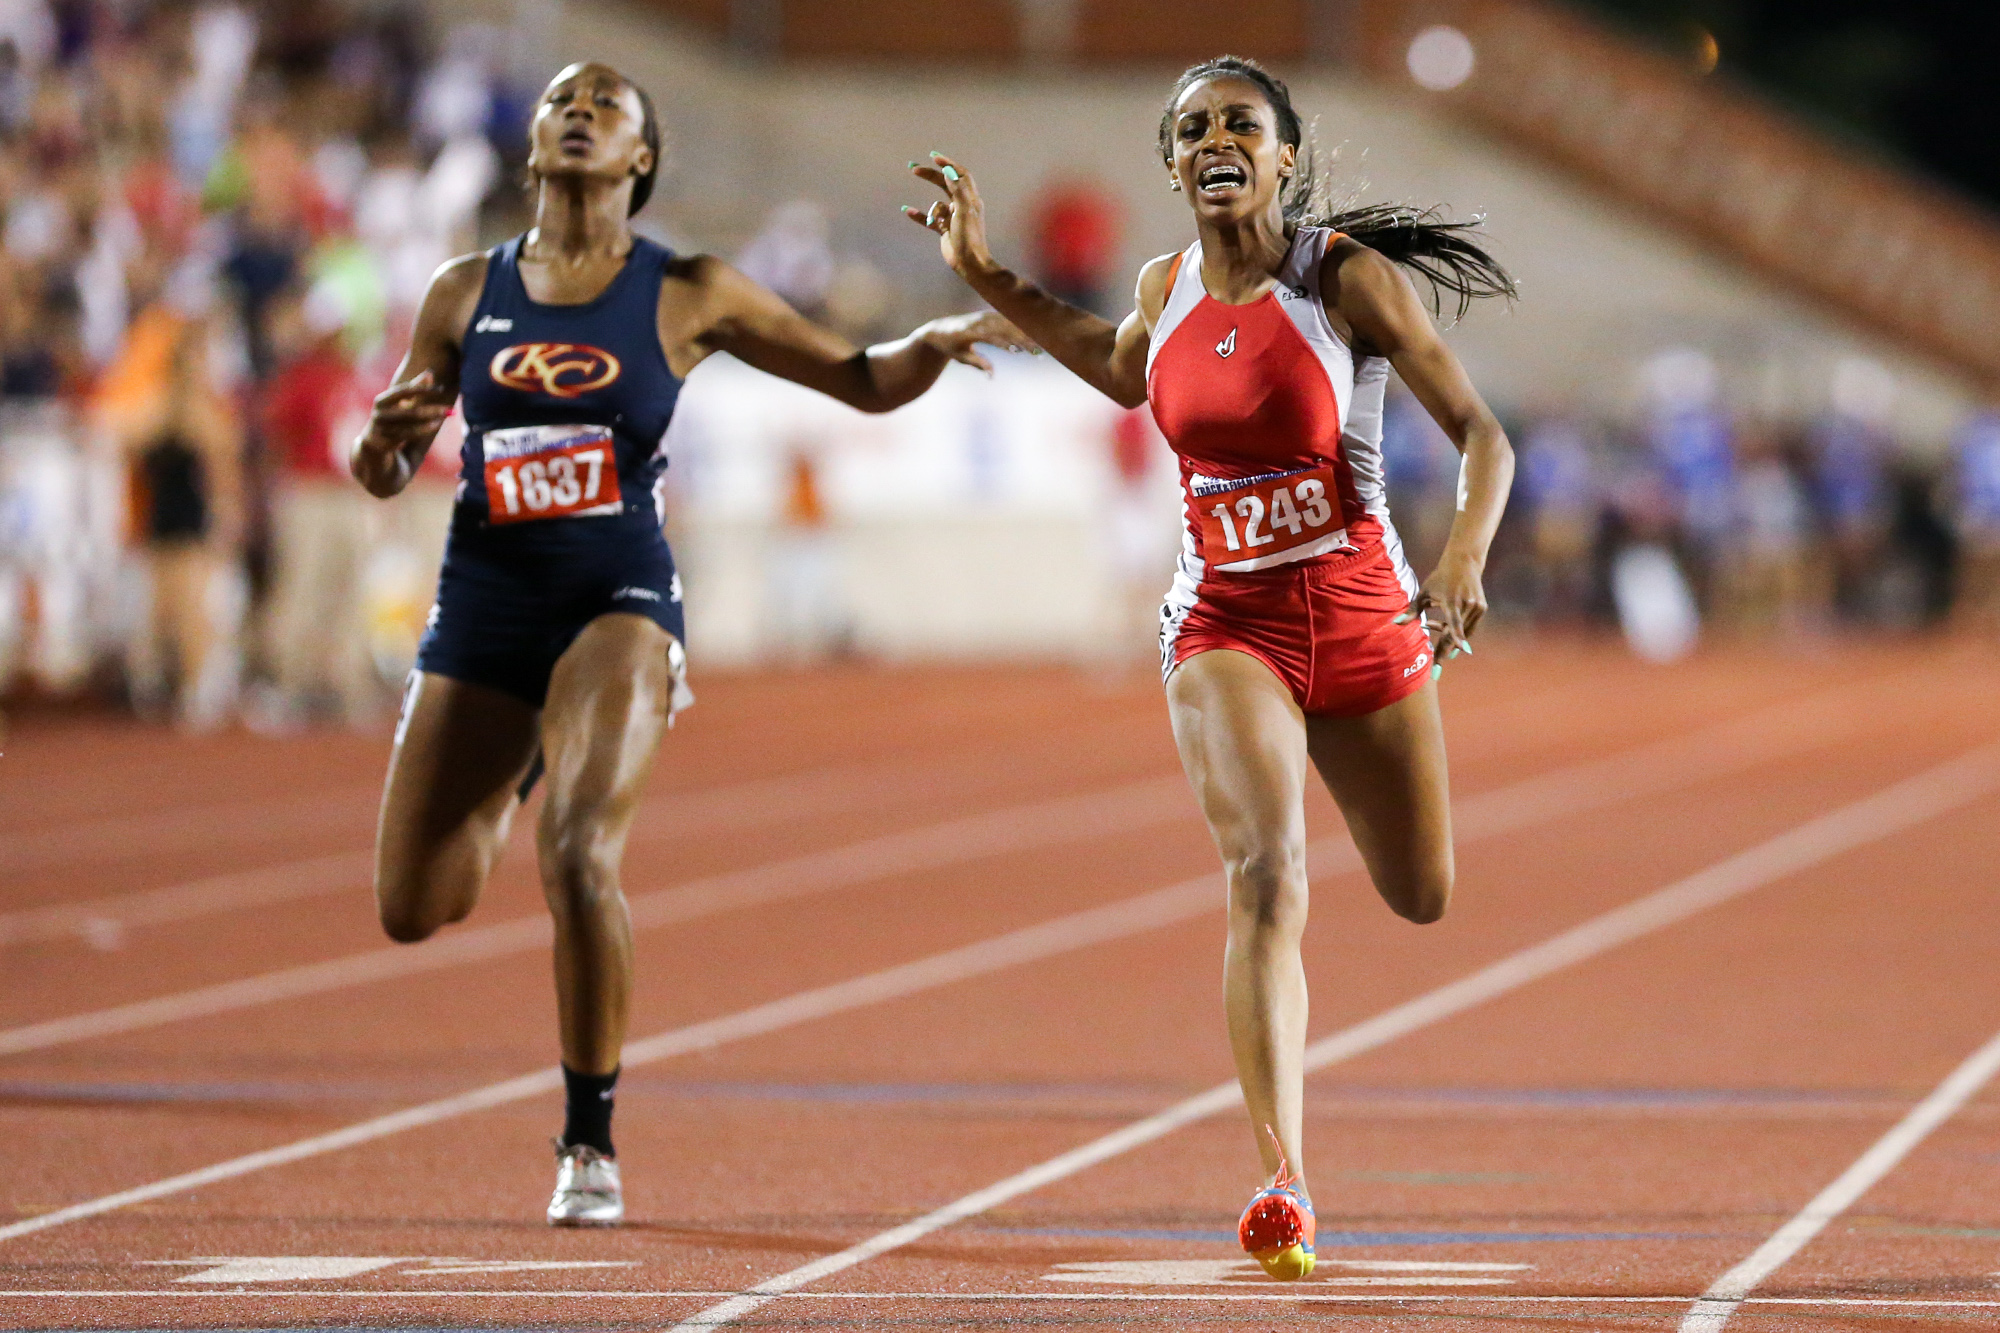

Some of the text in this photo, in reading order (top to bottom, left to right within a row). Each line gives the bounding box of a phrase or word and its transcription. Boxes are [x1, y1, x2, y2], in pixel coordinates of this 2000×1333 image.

[506, 343, 598, 398] KC
[495, 449, 605, 515] 1637
[1195, 484, 1223, 497] TRACK
[1210, 478, 1332, 552] 1243
